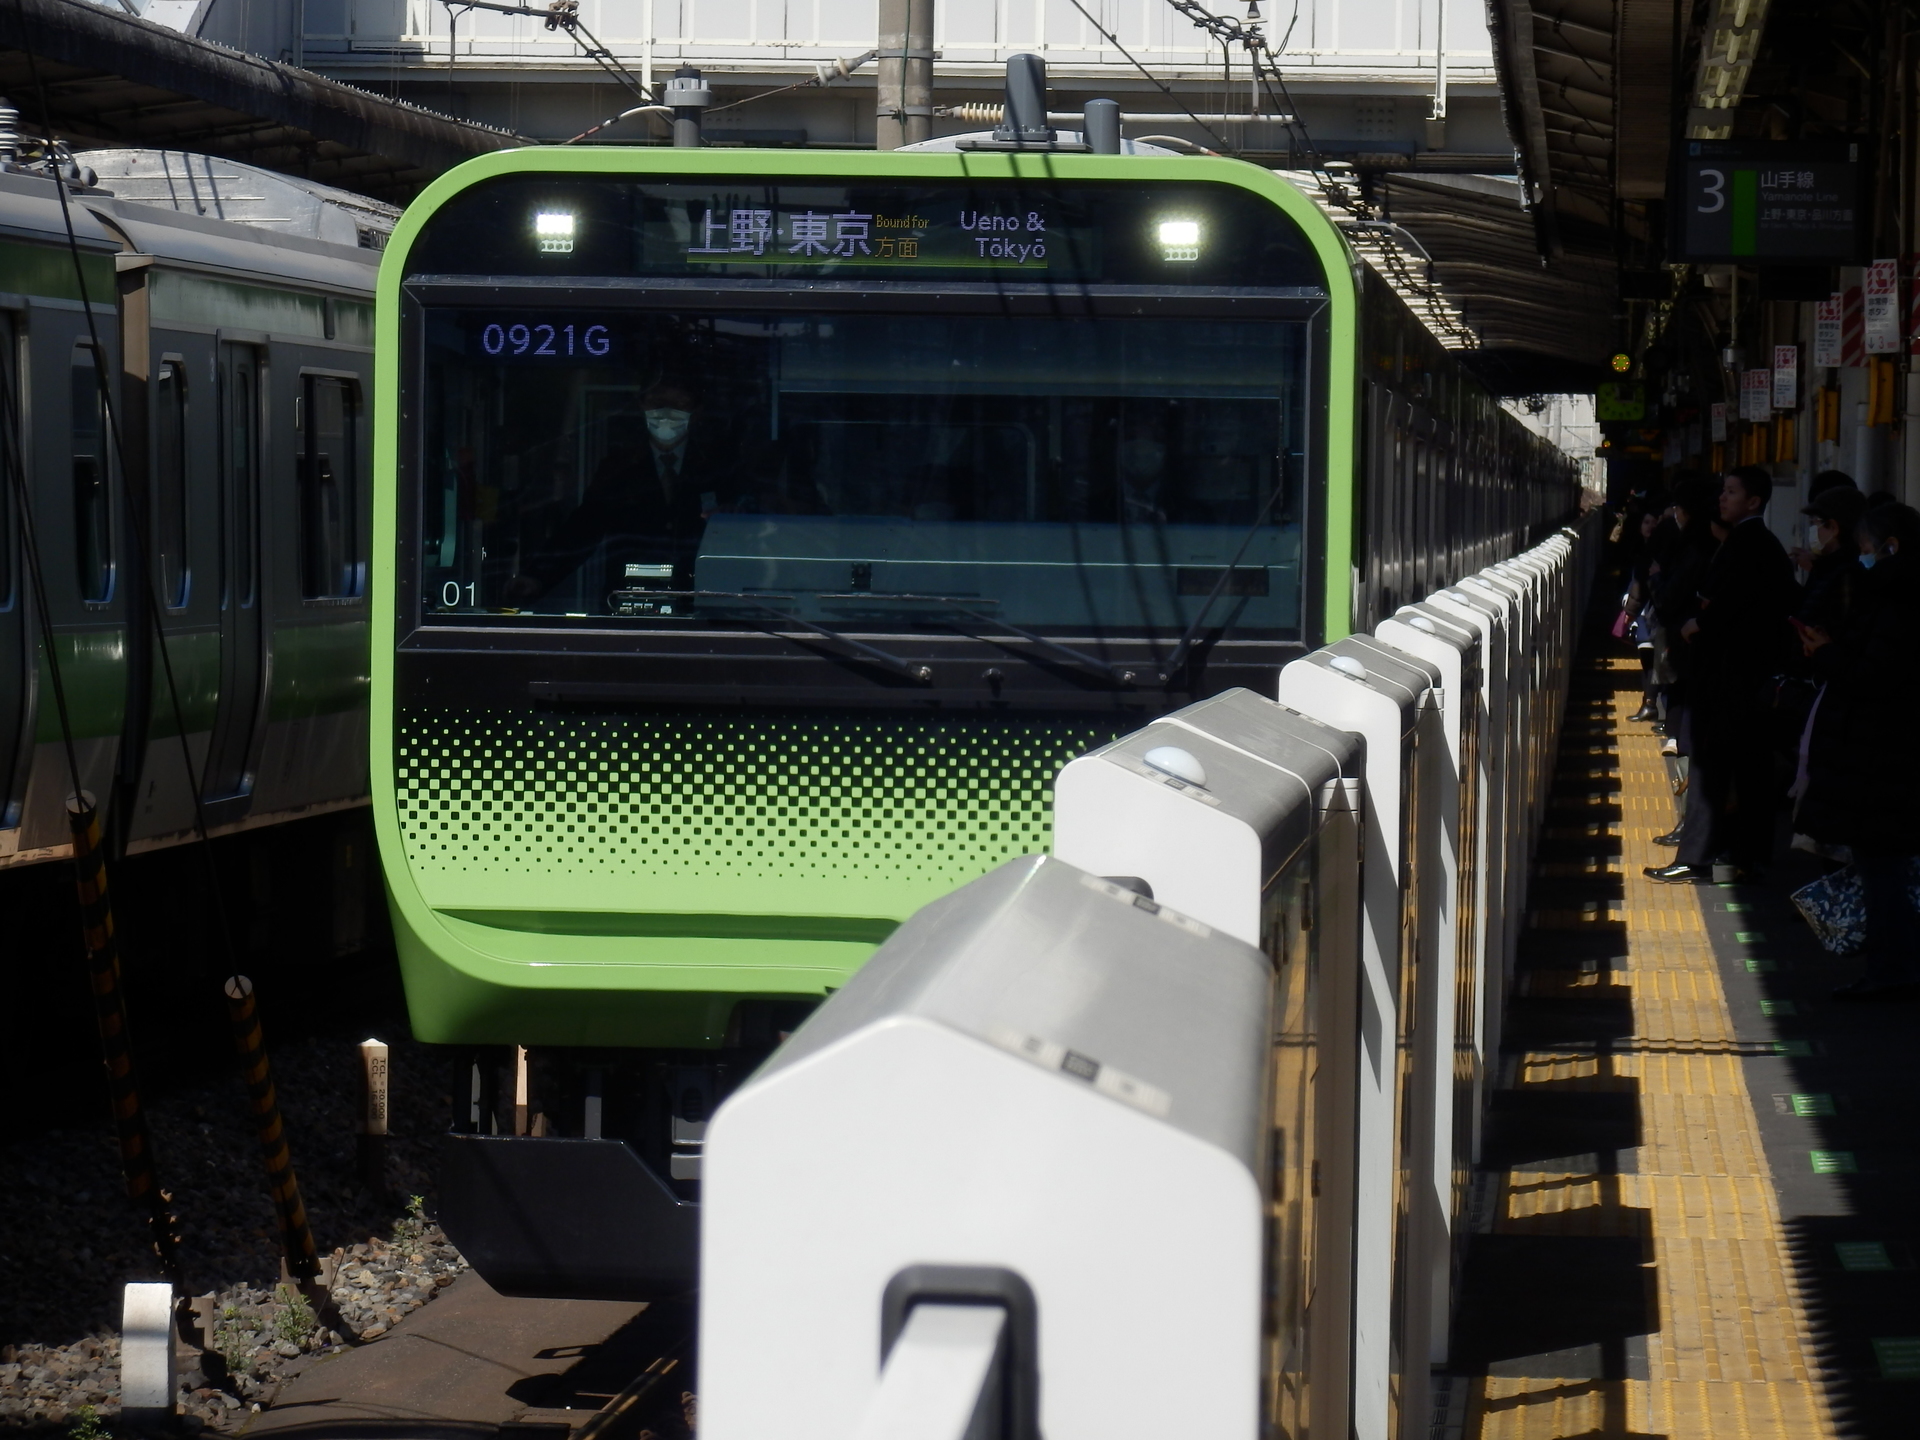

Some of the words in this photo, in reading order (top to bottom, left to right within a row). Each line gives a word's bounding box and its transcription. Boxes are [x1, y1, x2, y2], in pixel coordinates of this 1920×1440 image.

[1761, 170, 1815, 189] 山手線
[1697, 169, 1725, 213] 3
[1761, 192, 1813, 202] Yamanote
[1817, 192, 1839, 202] Line
[876, 214, 909, 229] Bound
[911, 214, 930, 229] for
[960, 210, 1020, 232] Ueno
[1026, 210, 1046, 232] &
[874, 236, 919, 259] 方面
[975, 236, 1046, 264] Tōkyō
[1868, 308, 1888, 316] ボタン
[483, 323, 611, 356] 0921G
[1878, 336, 1885, 350] 3
[441, 581, 477, 608] 01
